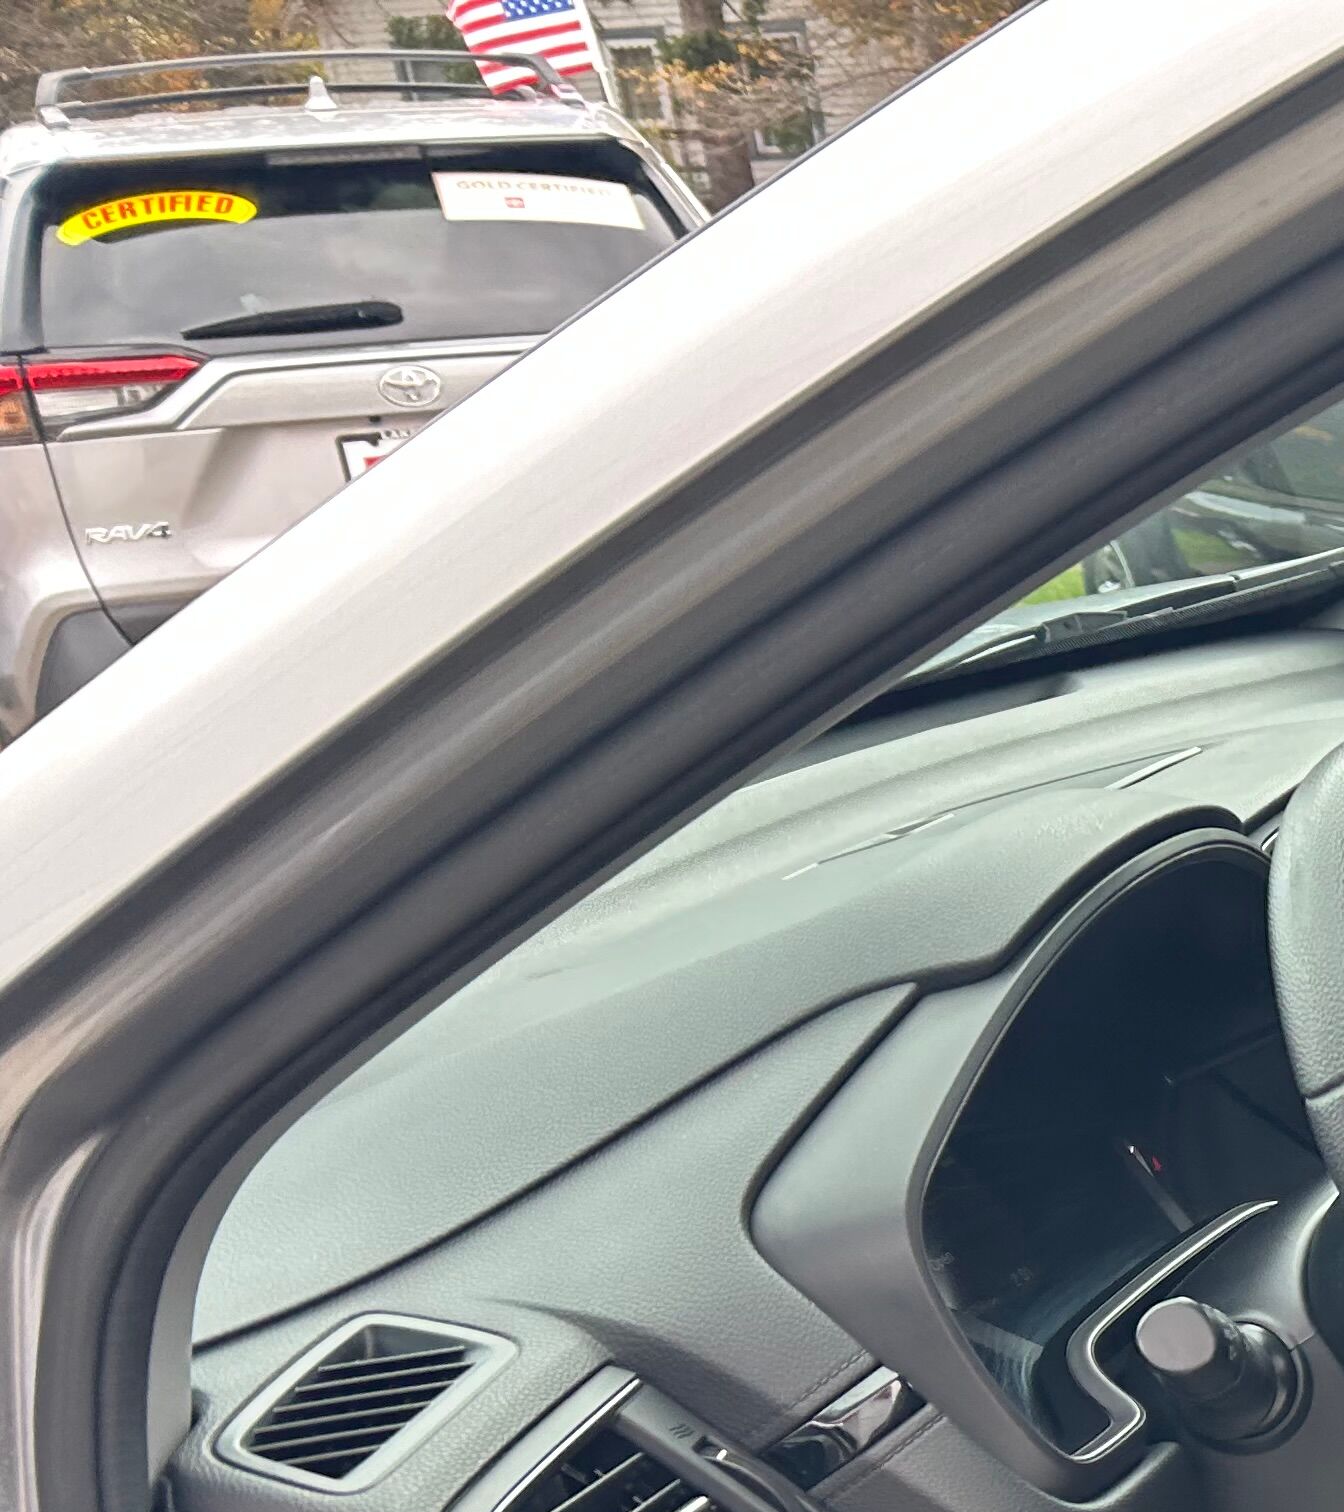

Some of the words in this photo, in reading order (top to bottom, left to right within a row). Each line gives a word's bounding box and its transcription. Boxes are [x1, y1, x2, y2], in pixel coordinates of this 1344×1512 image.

[456, 179, 511, 190] GOLD
[80, 194, 234, 230] CERTIFIED
[85, 521, 172, 545] RAV4
